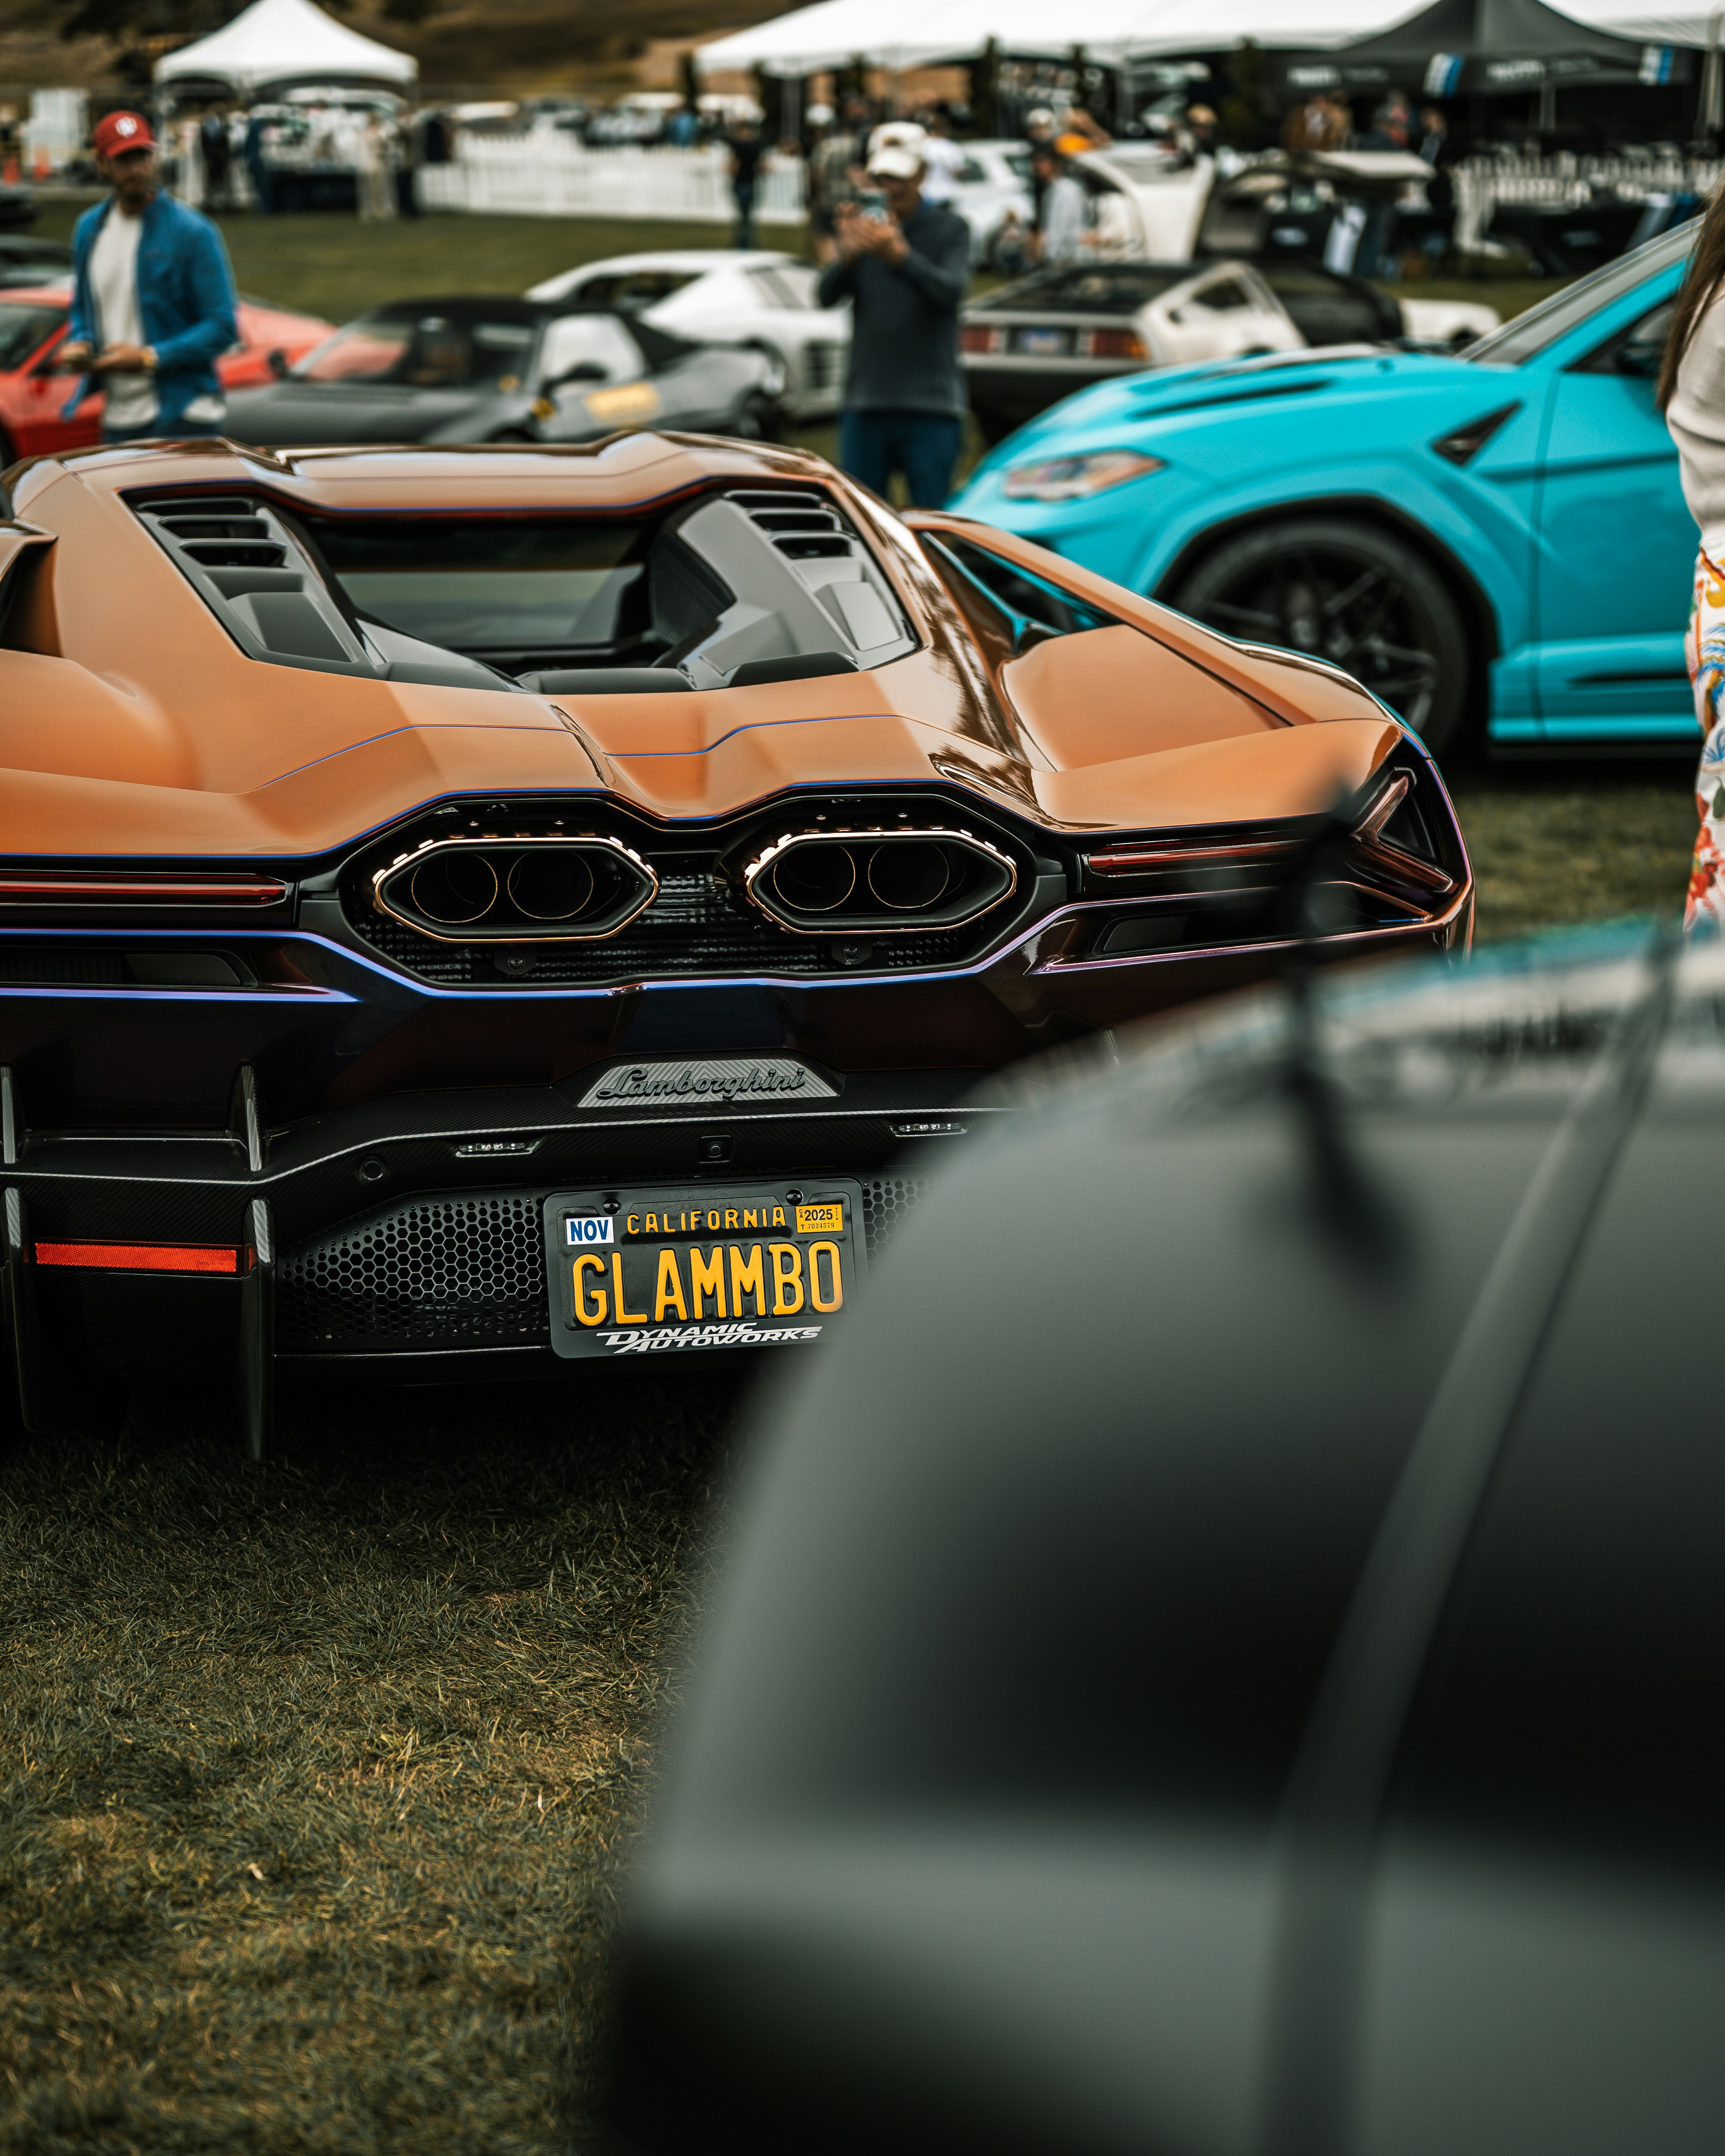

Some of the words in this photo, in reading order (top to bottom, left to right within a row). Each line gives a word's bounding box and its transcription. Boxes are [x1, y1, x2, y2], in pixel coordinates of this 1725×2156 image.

[597, 1068, 806, 1099] Lamborghini
[627, 1206, 786, 1234] CALIFORNIA
[804, 1209, 833, 1221] 2025
[570, 1219, 609, 1242] NOV
[573, 1241, 843, 1326] GLAMMBO
[596, 1322, 757, 1346] DYNAMIC
[613, 1326, 823, 1354] AUTOWORKS
